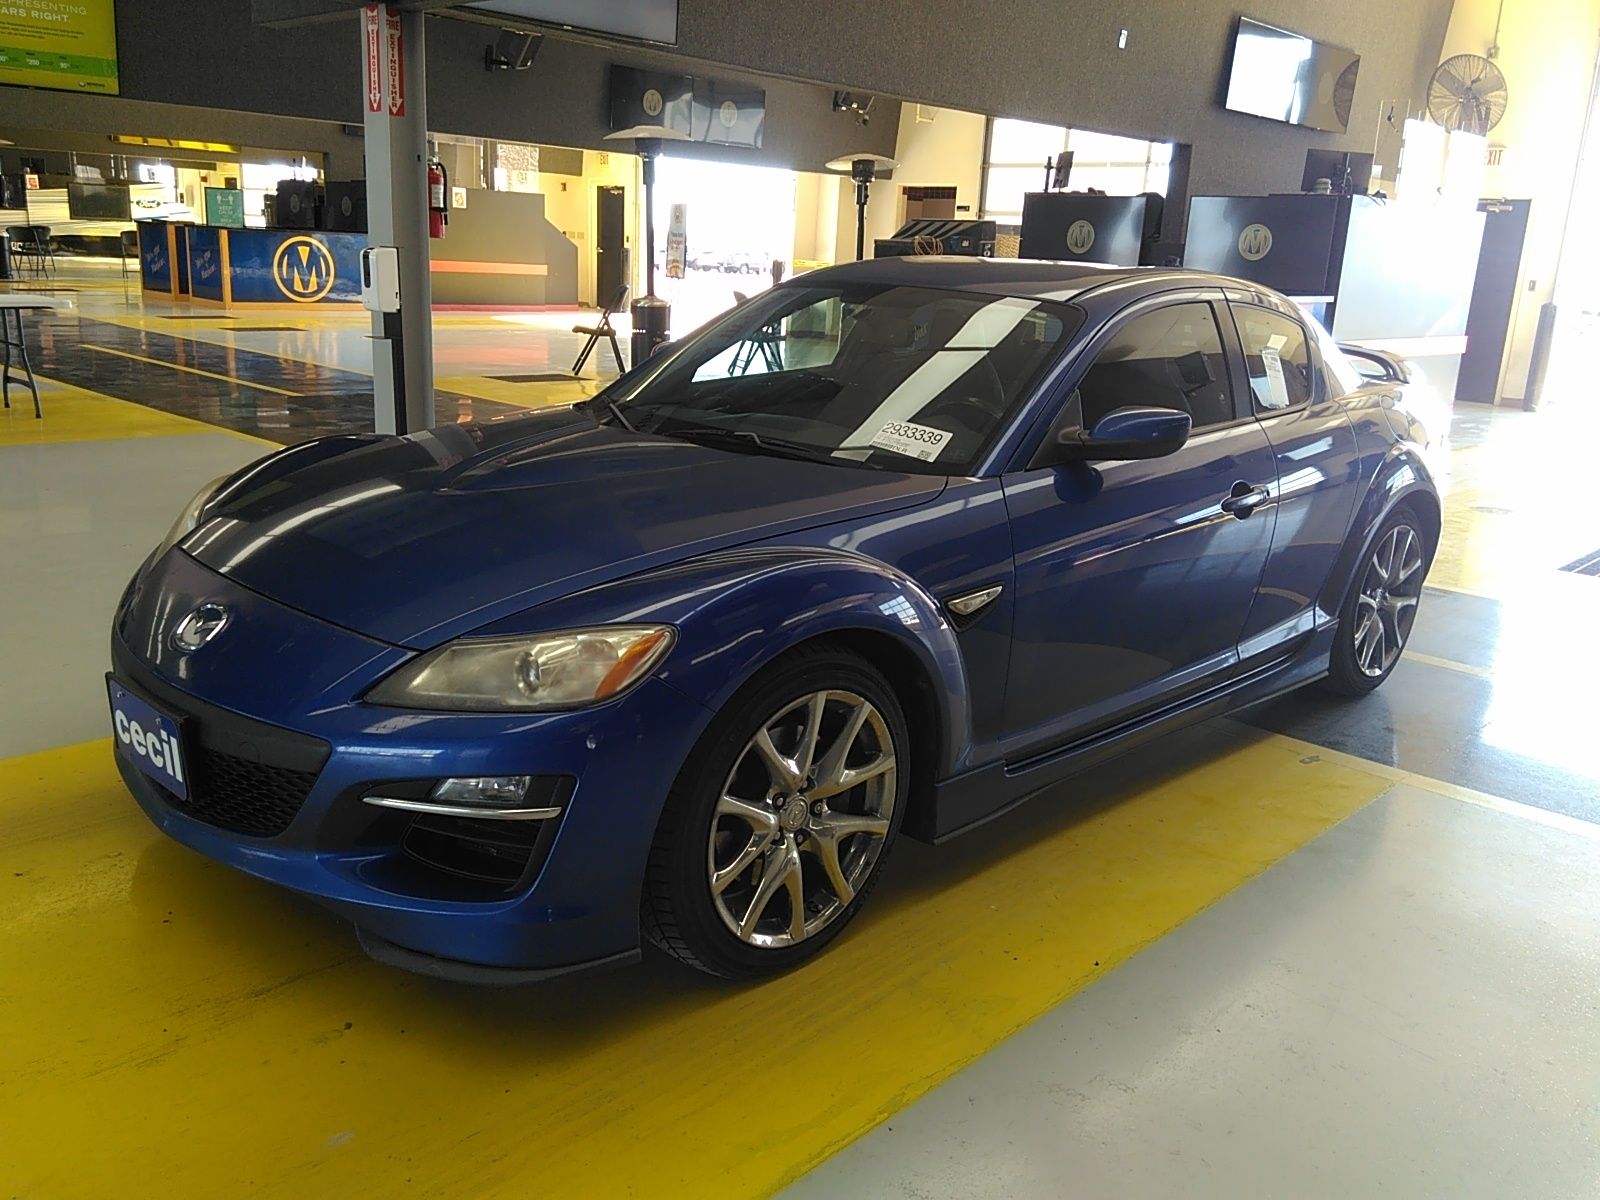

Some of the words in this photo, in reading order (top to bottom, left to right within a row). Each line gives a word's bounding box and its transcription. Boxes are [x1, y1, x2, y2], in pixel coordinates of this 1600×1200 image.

[390, 33, 398, 108] EXTINGUISHER
[881, 422, 943, 446] 2933339
[115, 709, 183, 783] cecil
